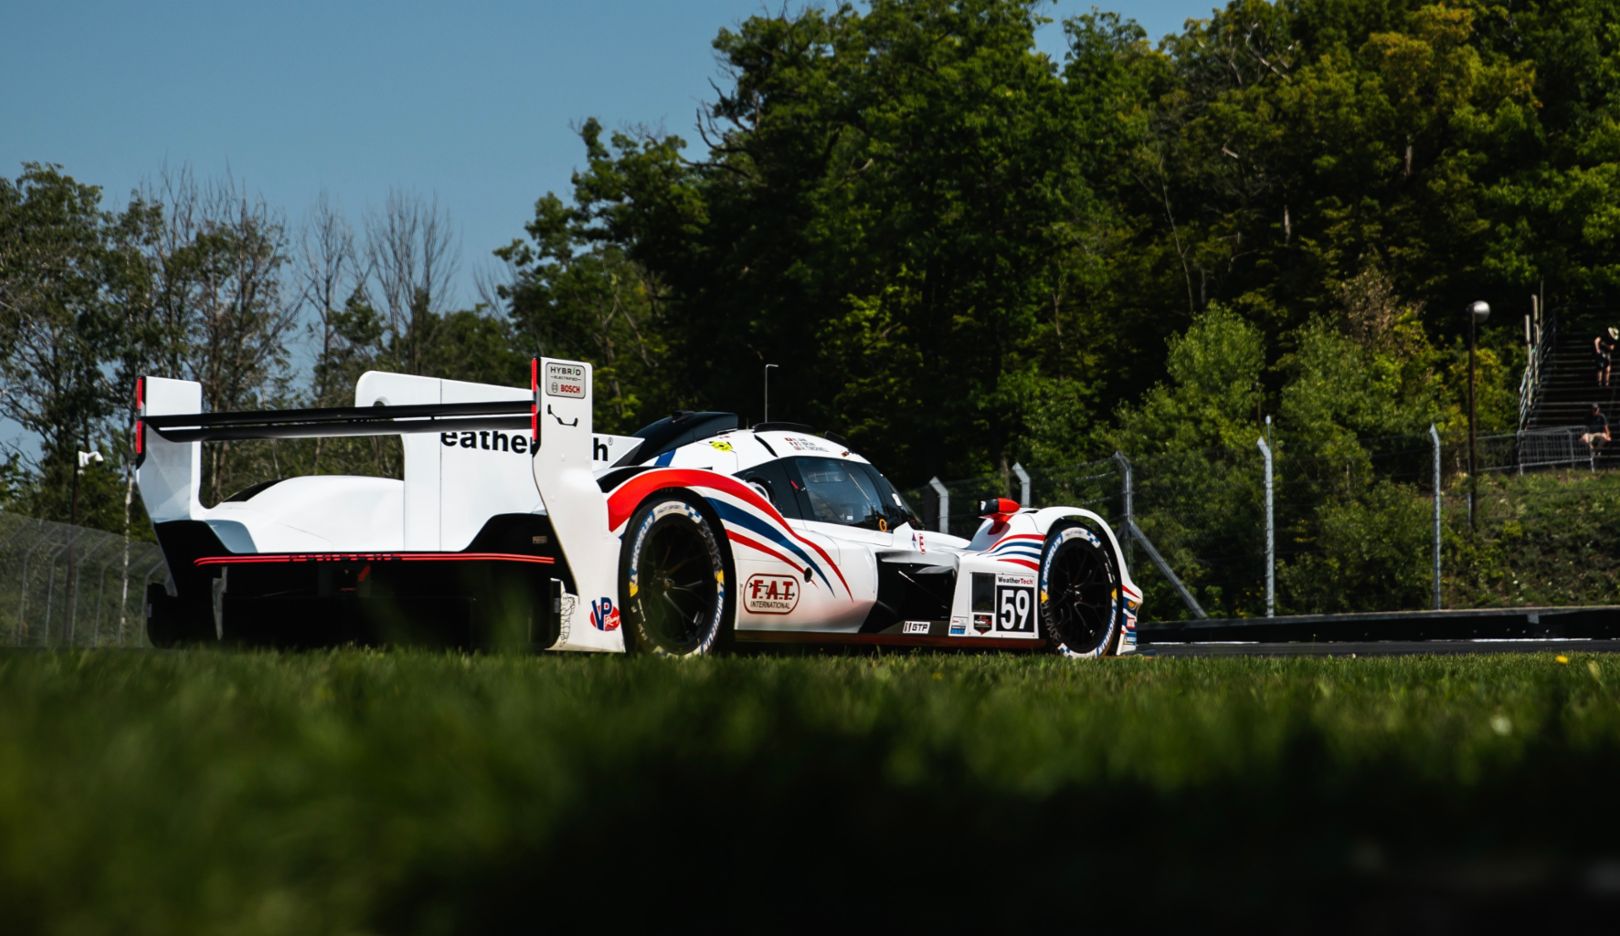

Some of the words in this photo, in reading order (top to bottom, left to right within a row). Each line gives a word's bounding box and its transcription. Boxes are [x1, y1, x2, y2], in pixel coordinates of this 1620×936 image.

[560, 384, 581, 393] BOSCH
[998, 576, 1034, 585] WeatherTech
[751, 601, 790, 609] INTERNATIONAL
[1001, 589, 1030, 630] 59
[591, 597, 613, 631] VP
[912, 624, 928, 632] GTP
